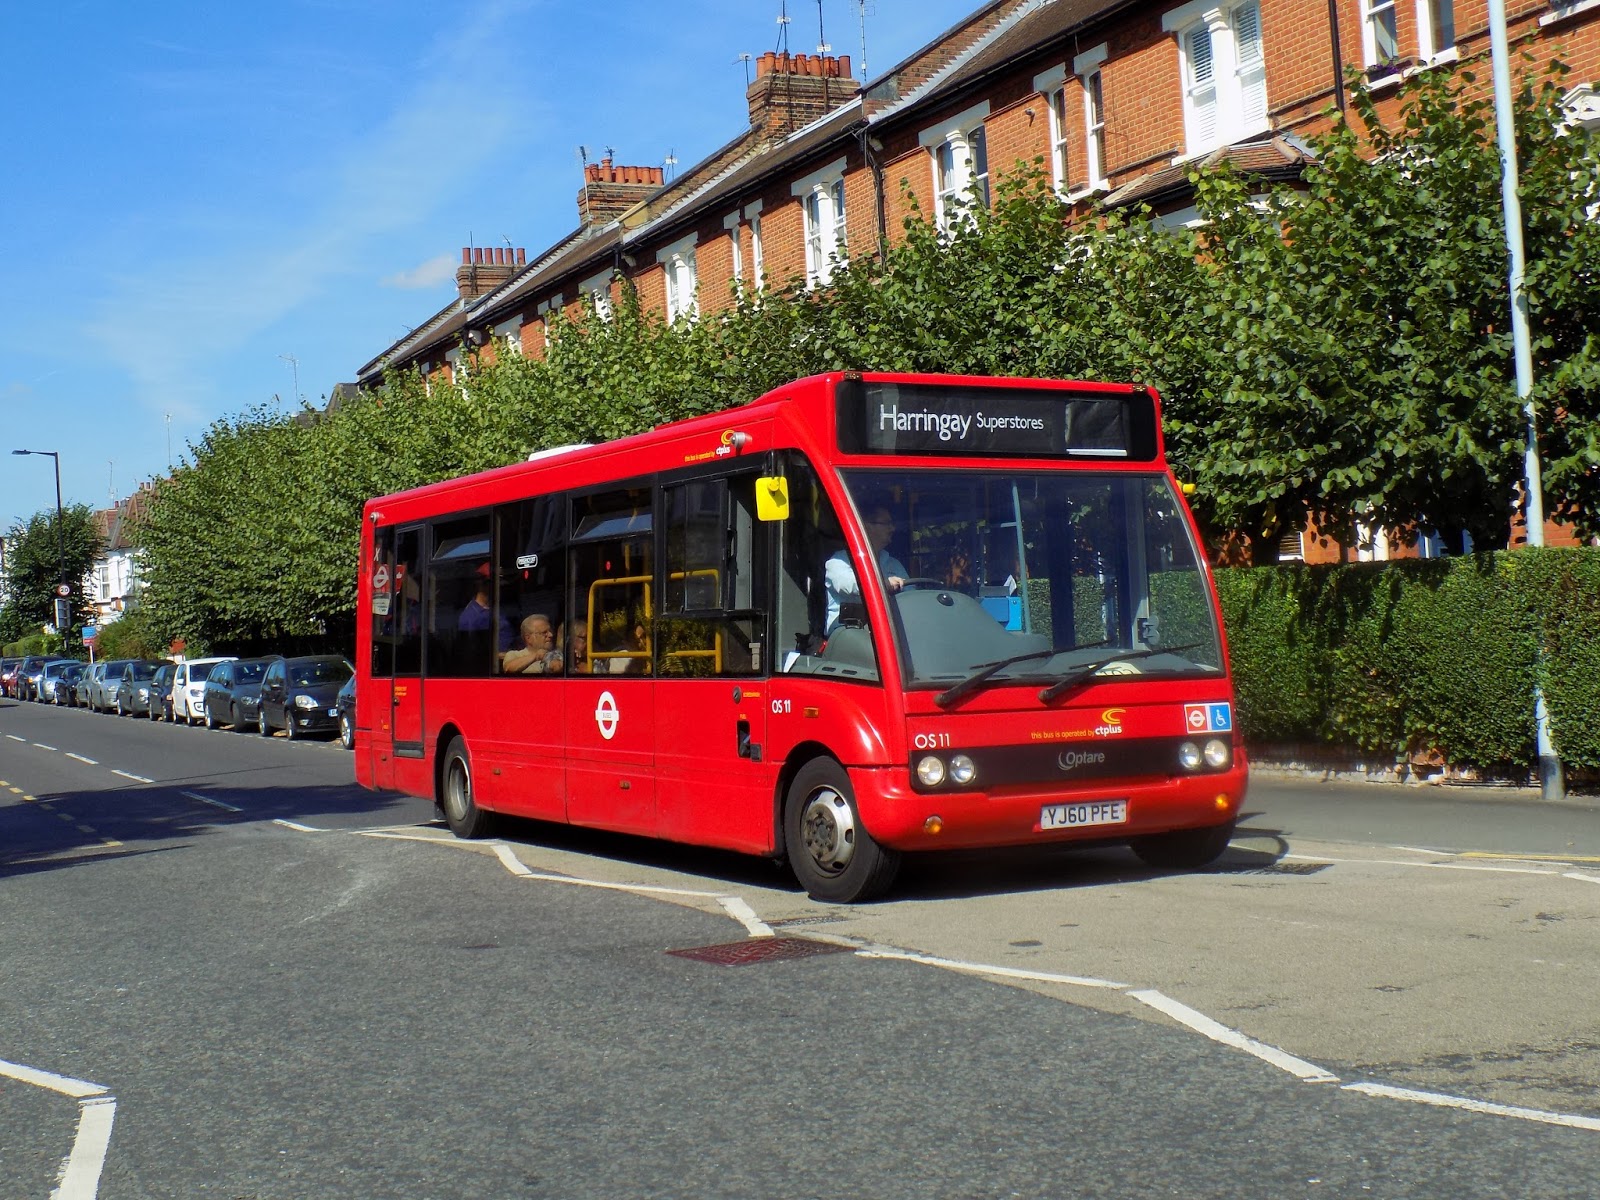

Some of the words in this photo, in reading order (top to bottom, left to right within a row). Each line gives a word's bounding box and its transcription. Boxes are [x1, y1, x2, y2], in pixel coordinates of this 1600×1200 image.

[879, 403, 972, 441] Harringay
[976, 411, 1044, 433] Superstores
[1043, 731, 1054, 739] bus
[1055, 730, 1061, 738] is
[1061, 729, 1087, 739] operated
[1087, 729, 1095, 738] by
[1095, 724, 1122, 737] ctplus
[1065, 751, 1106, 768] Optare
[1048, 806, 1087, 825] YJ60
[1091, 803, 1120, 822] PFE
